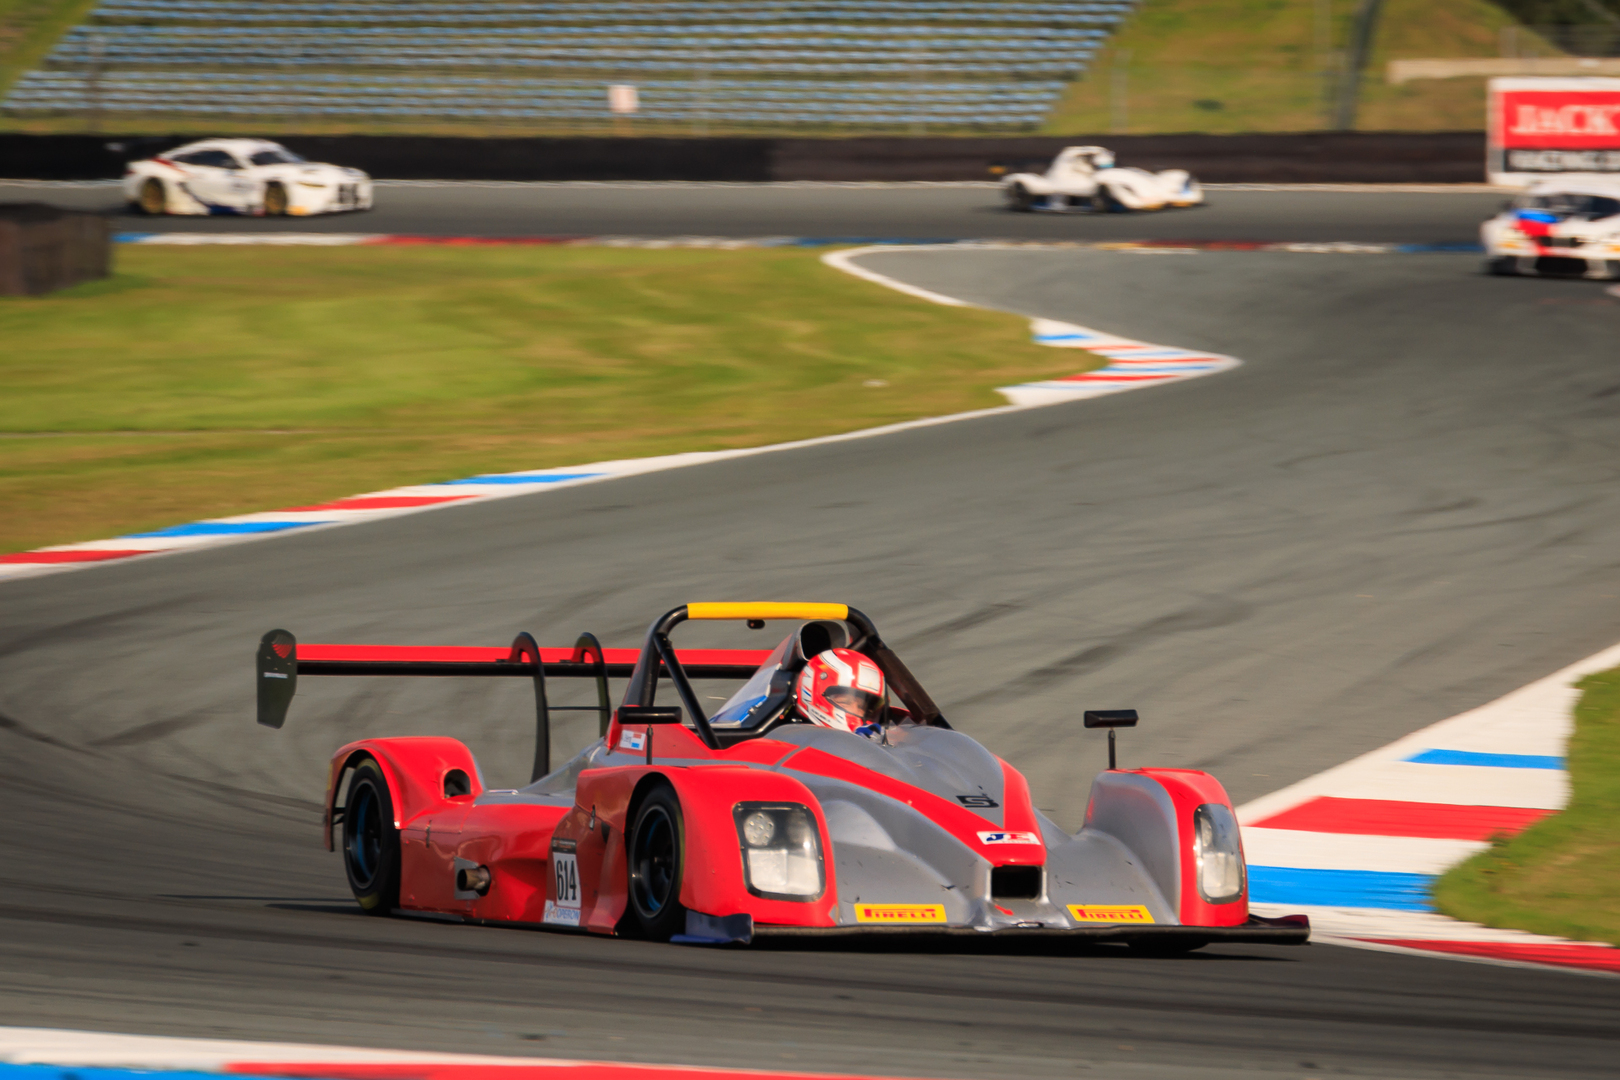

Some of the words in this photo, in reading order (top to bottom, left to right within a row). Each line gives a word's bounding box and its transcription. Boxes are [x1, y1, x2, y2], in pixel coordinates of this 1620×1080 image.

[556, 860, 577, 901] 614
[863, 908, 936, 919] PIRELLI
[1076, 909, 1144, 920] PIRELLI
